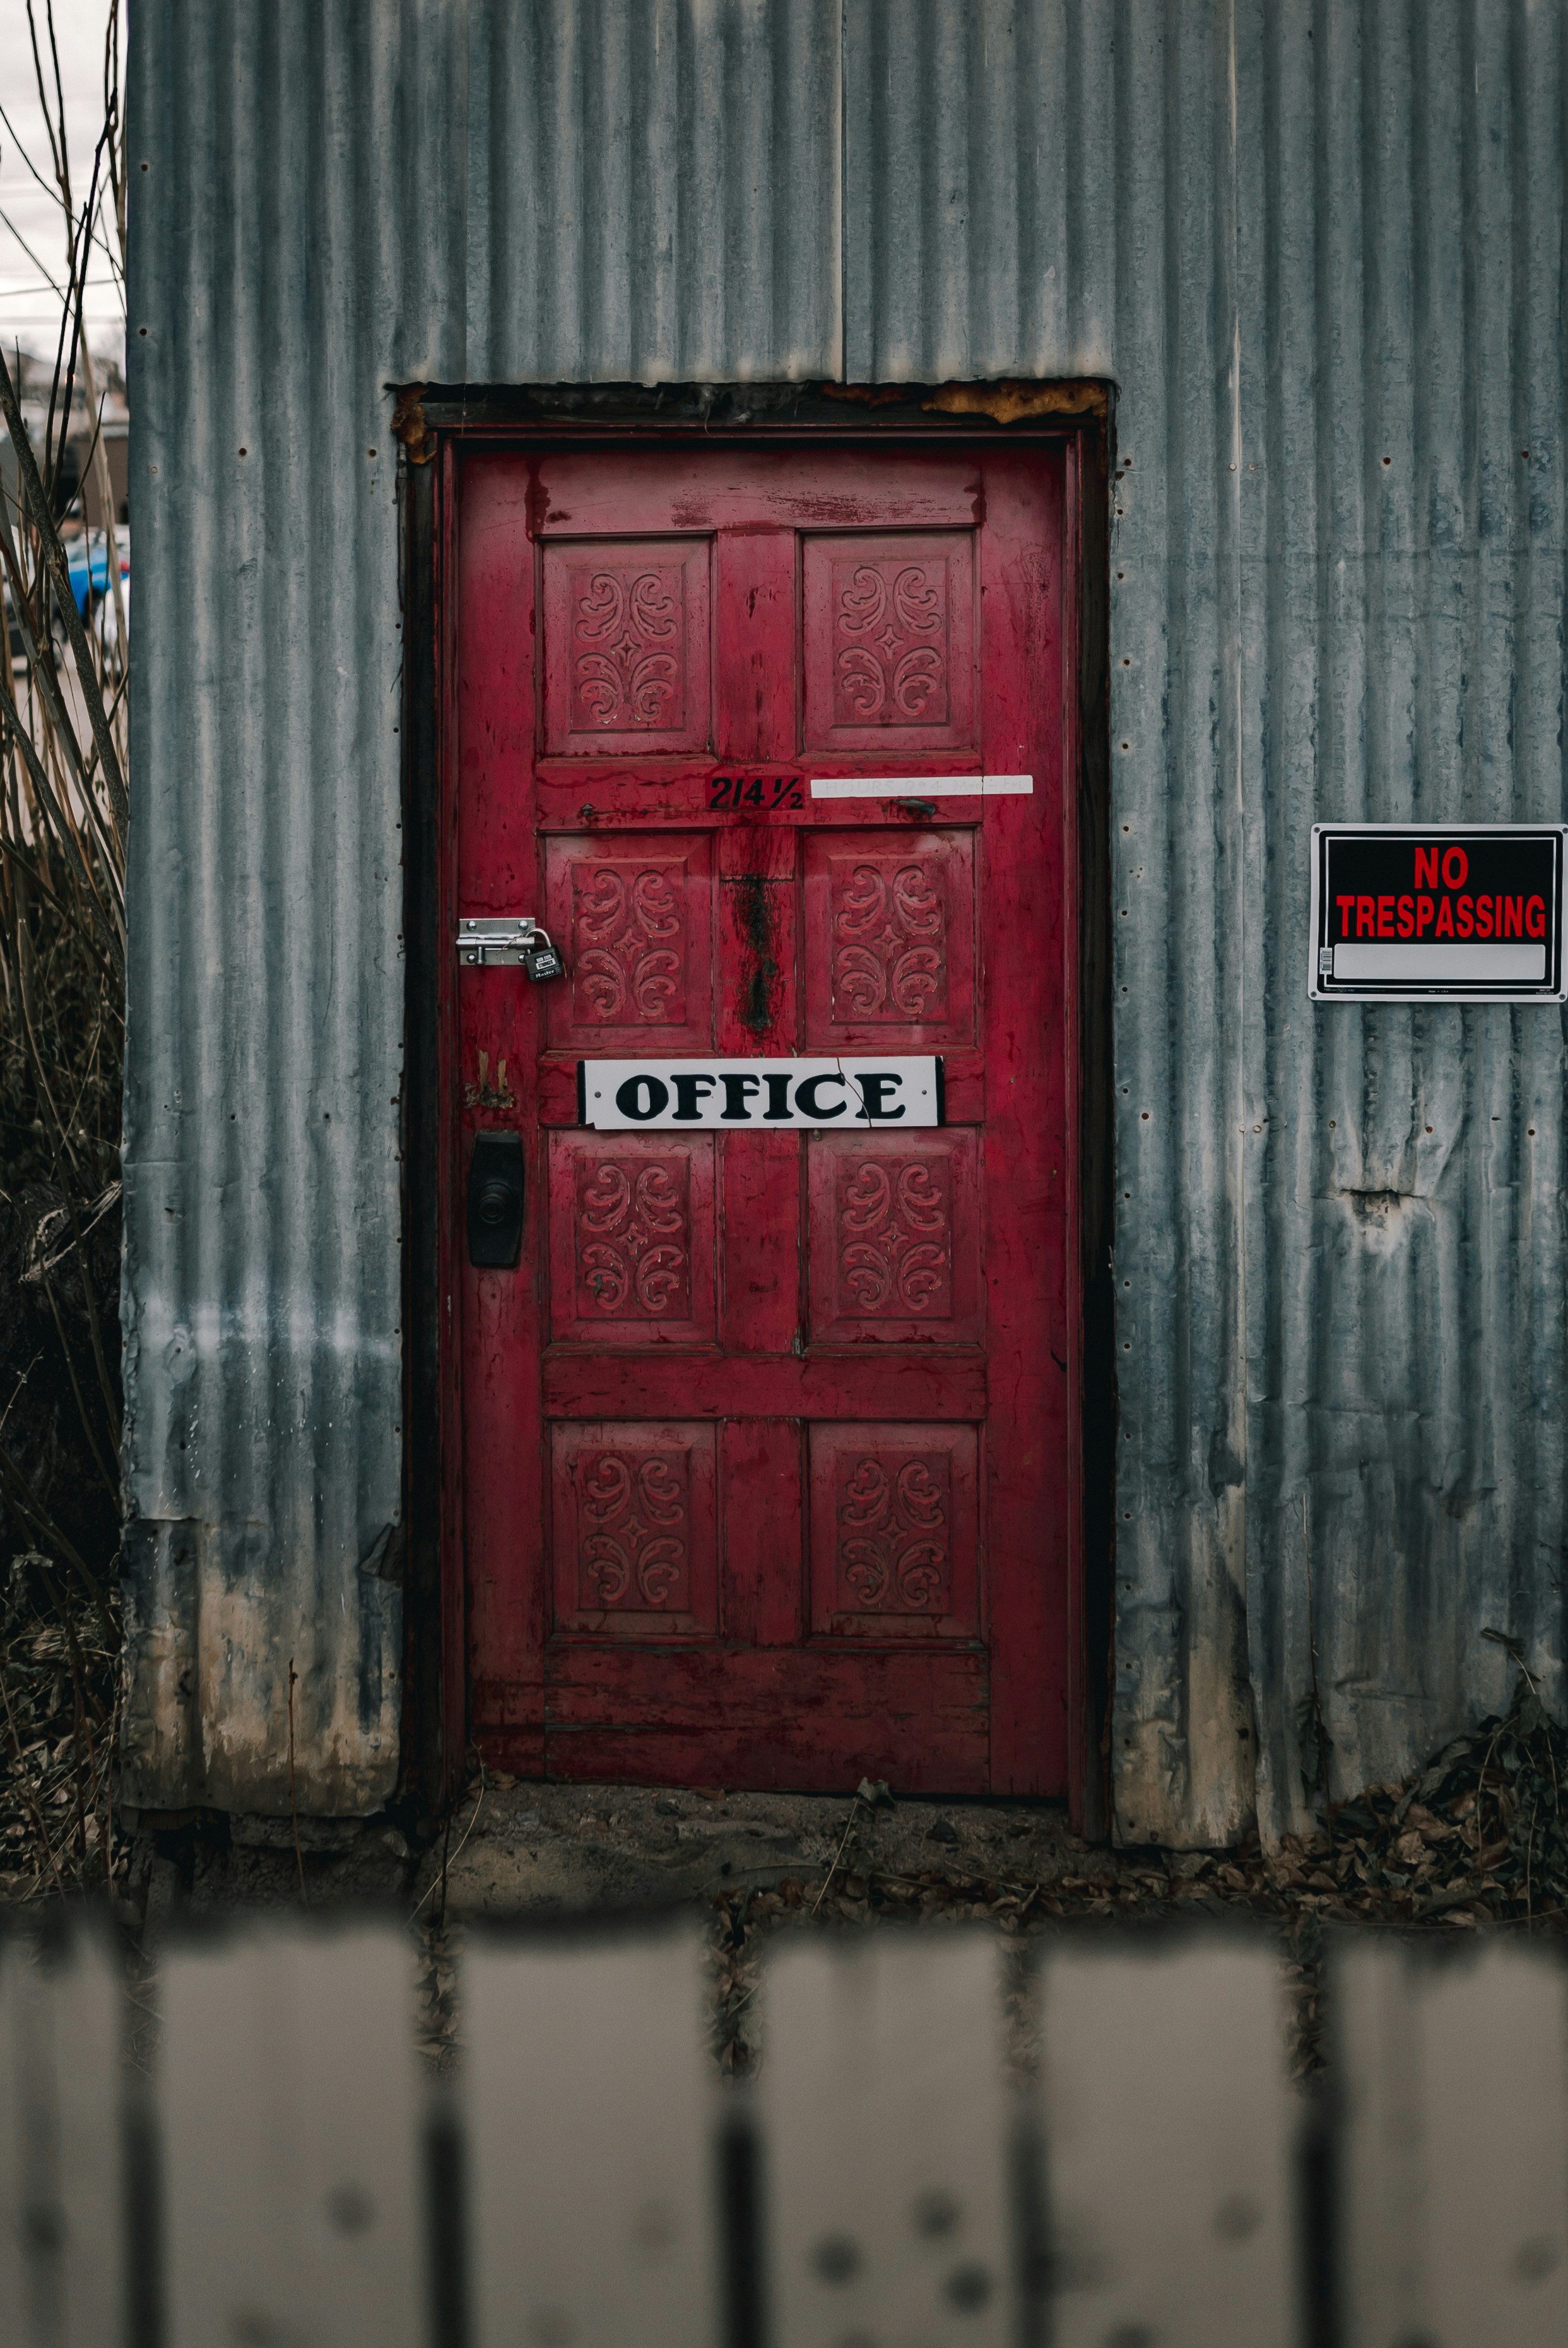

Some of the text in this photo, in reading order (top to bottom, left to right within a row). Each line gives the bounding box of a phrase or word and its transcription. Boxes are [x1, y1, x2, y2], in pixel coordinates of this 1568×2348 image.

[709, 777, 765, 809] 214
[825, 780, 895, 795] HOURS
[931, 780, 943, 792] 4
[1003, 778, 1024, 790] Fri
[1414, 846, 1469, 889] NO
[1336, 894, 1546, 938] TRESPASSING
[615, 1073, 906, 1120] OFFICE
